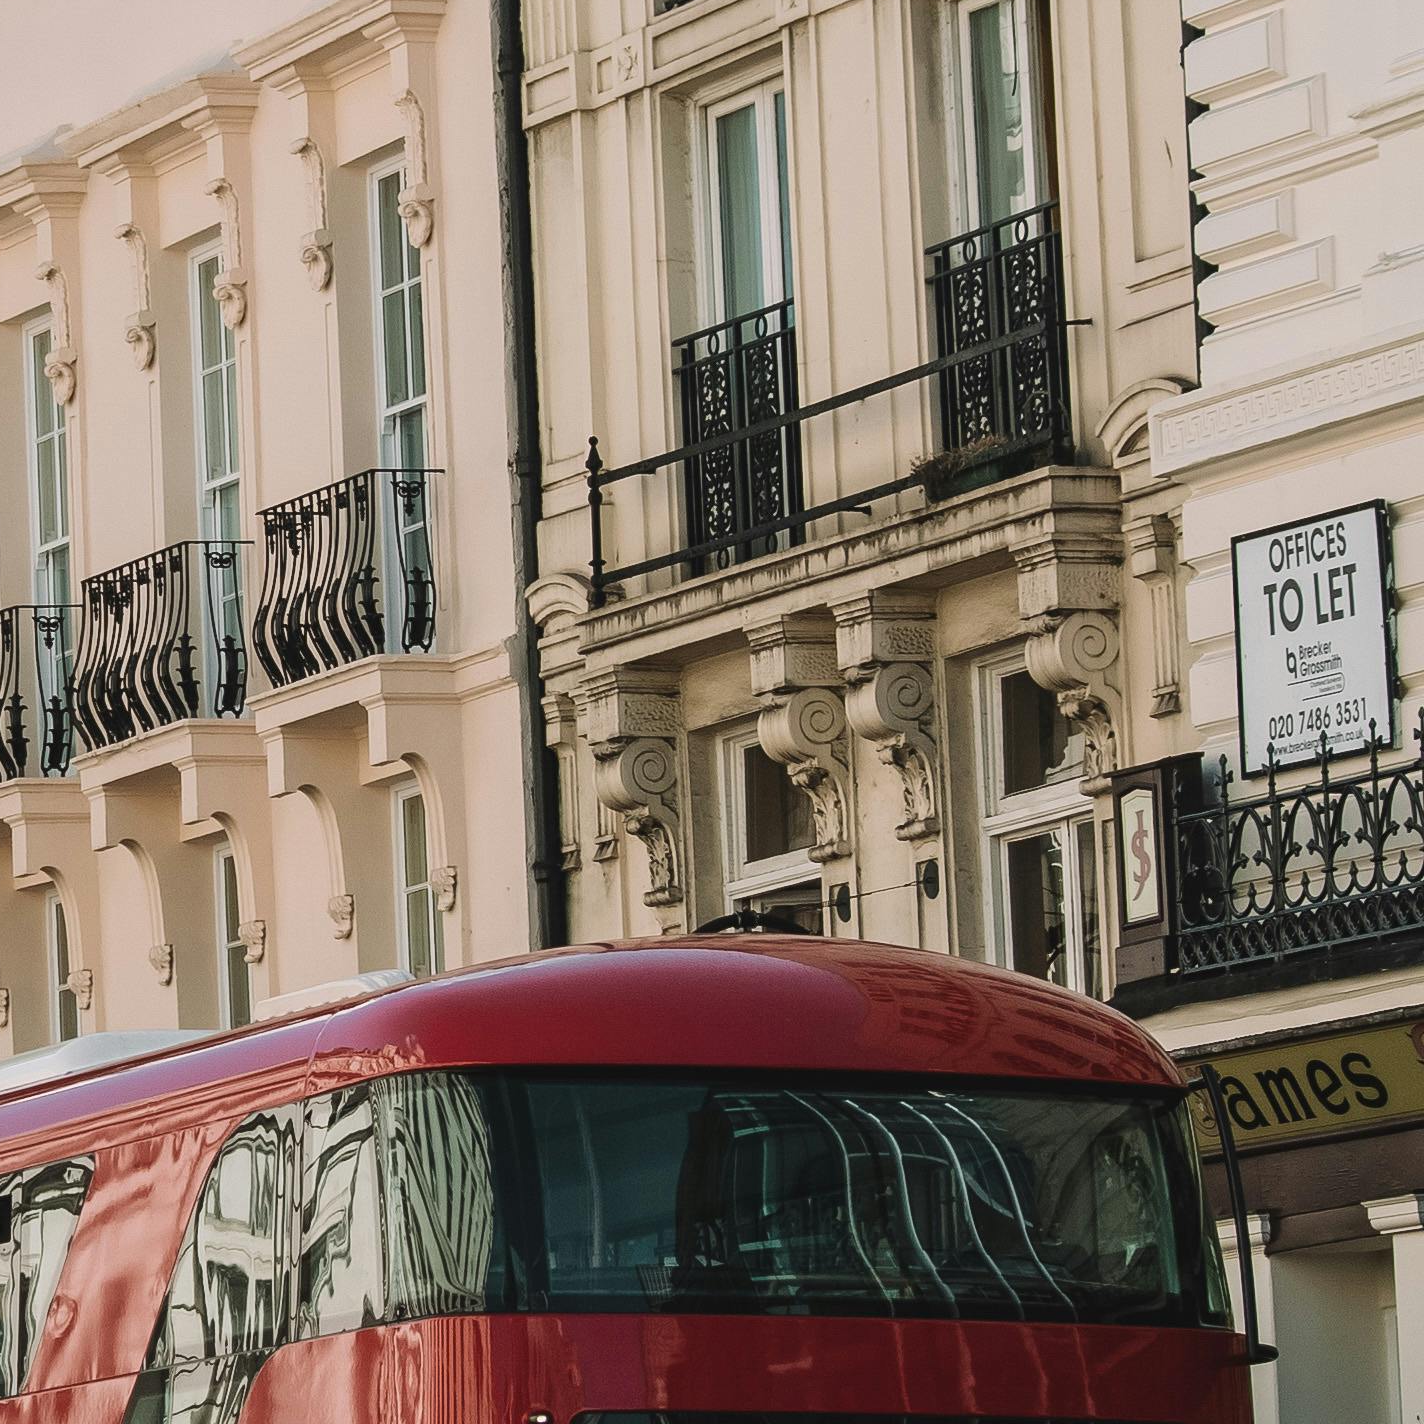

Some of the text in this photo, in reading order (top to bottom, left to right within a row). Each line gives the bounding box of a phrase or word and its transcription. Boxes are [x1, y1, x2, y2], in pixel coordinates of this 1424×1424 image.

[1269, 521, 1346, 572] OFFICES
[1263, 563, 1357, 635] TO LET
[1299, 641, 1331, 660] Brecker
[1300, 656, 1342, 676] Grossmith
[1269, 697, 1367, 740] 020 7486 3531
[1190, 1052, 1389, 1130] ames
